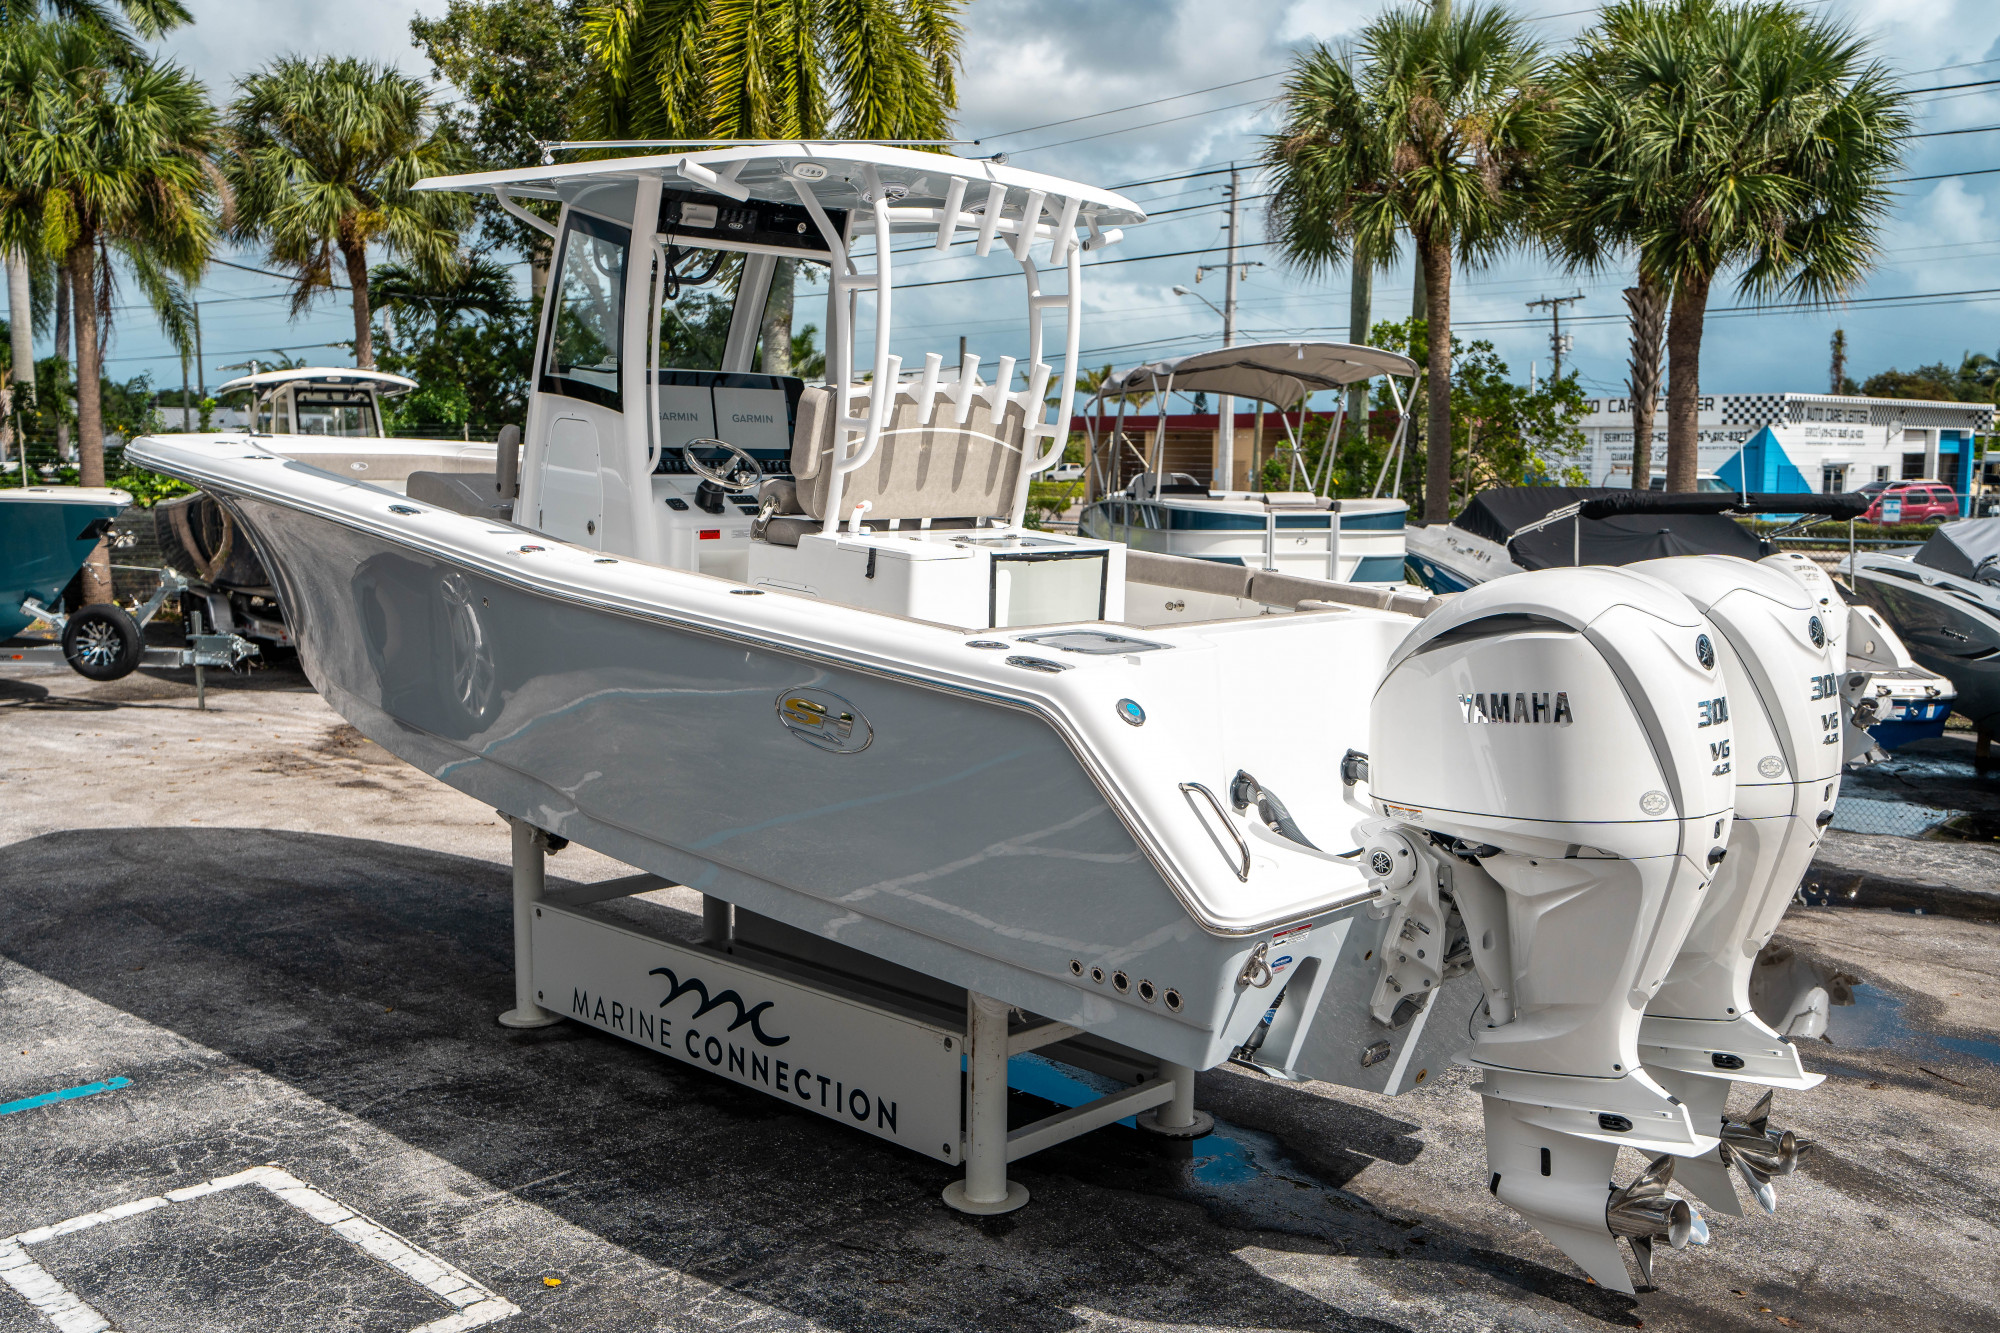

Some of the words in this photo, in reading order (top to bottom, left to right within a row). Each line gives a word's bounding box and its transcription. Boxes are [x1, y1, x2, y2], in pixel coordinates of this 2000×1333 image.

[732, 413, 774, 424] GARMIN
[1458, 691, 1574, 724] YAMAHA
[572, 986, 673, 1050] MARINE
[685, 1028, 897, 1135] CONNECTION
